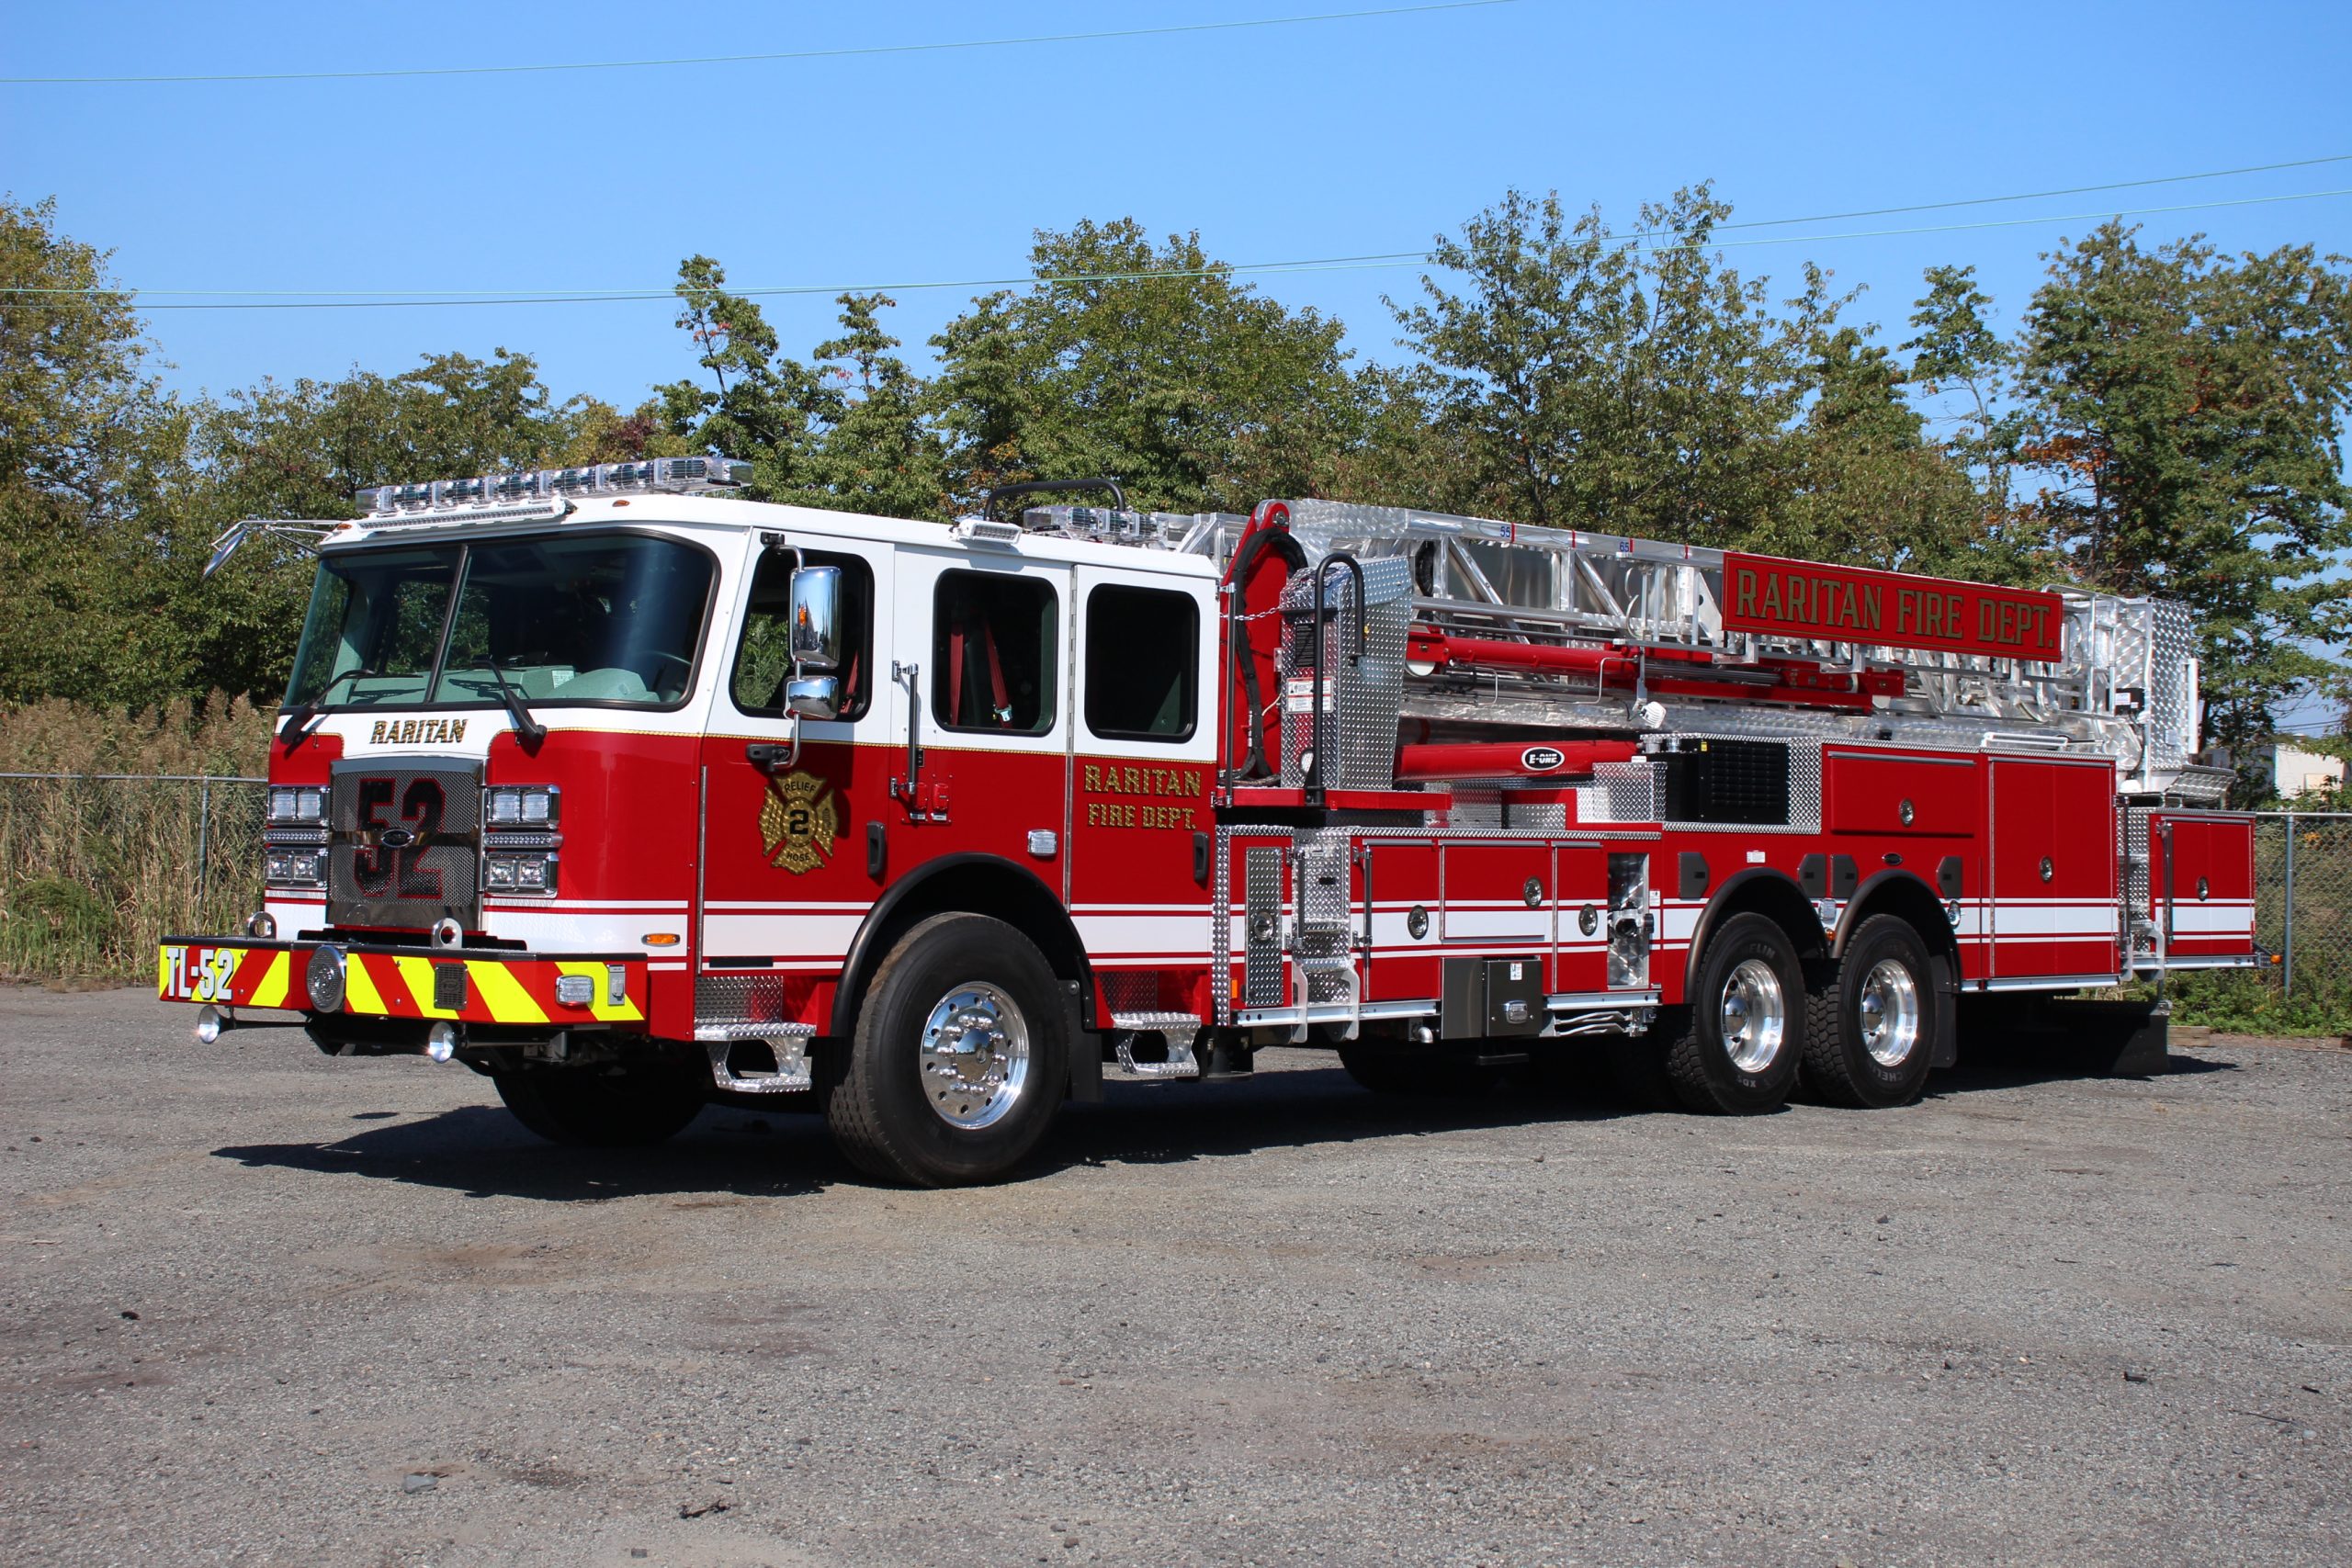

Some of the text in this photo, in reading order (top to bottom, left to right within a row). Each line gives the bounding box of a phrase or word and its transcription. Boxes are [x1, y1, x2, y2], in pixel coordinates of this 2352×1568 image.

[1500, 525, 1511, 538] 55
[1620, 541, 1630, 552] 65
[1736, 568, 2054, 649] RARITAN FIRE DEPT.
[369, 718, 469, 745] RARITAN
[1529, 753, 1558, 764] E-ONE
[784, 781, 816, 794] RELIEF
[1084, 764, 1202, 797] RARITAN
[790, 809, 809, 835] 2
[1088, 803, 1196, 829] FIRE DEPT.
[353, 777, 447, 900] 52
[786, 852, 810, 863] HOSE
[166, 947, 234, 1001] TL-52
